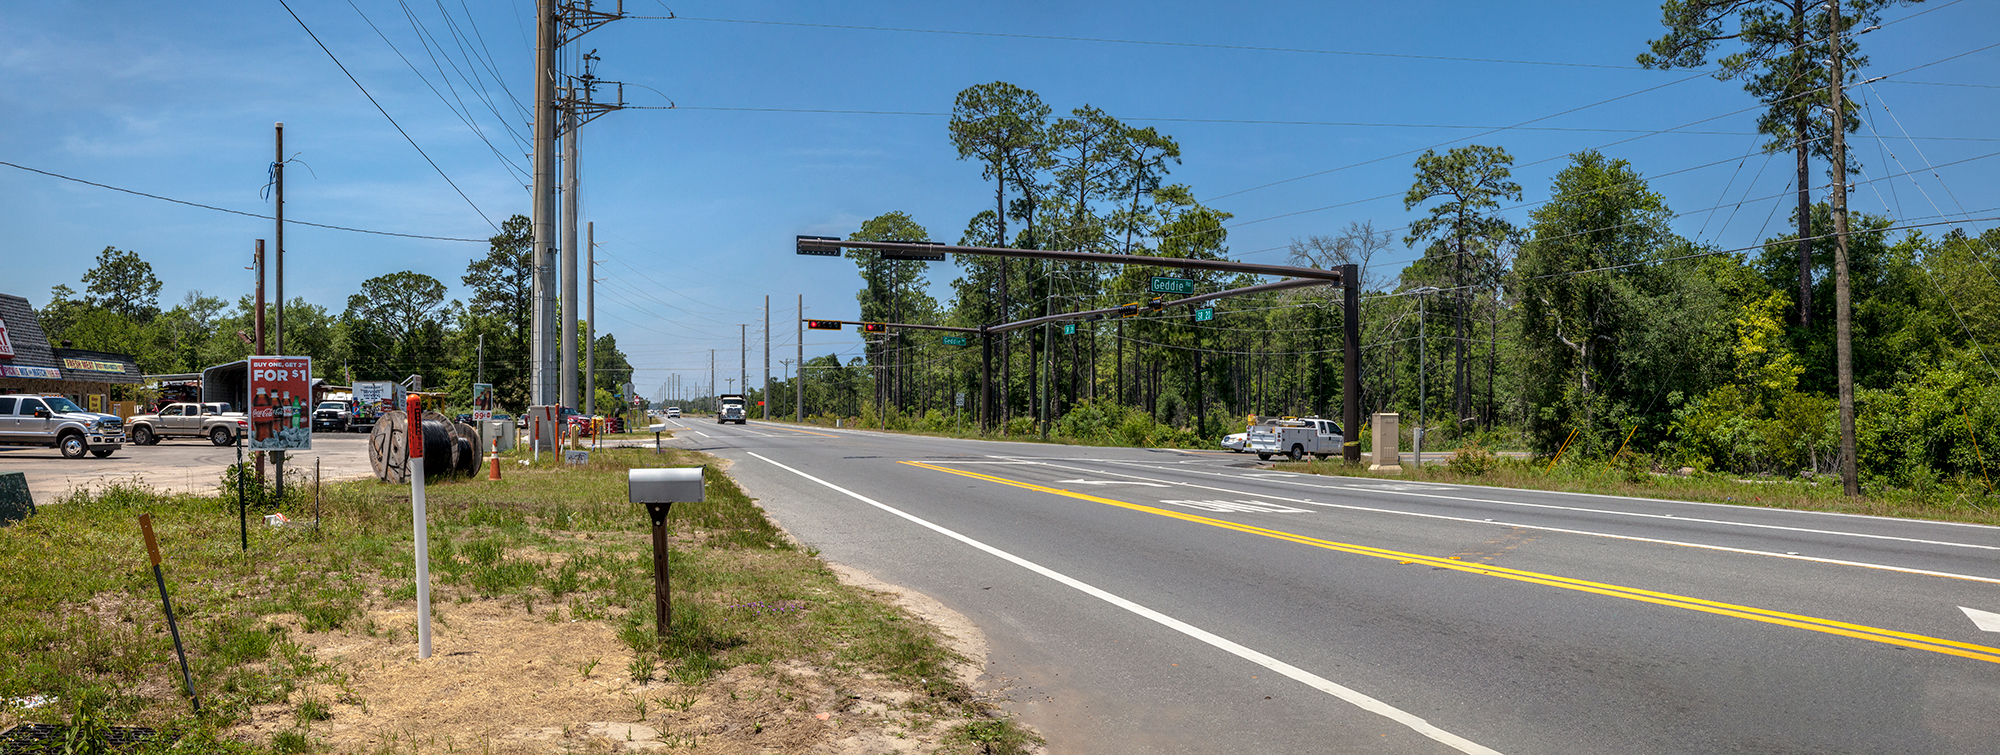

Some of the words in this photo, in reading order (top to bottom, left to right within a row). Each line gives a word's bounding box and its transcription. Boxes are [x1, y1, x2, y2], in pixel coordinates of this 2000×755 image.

[1154, 279, 1184, 291] Geddie
[253, 369, 289, 381] FOR
[291, 369, 307, 381] $1
[1159, 500, 1317, 513] ONLY
